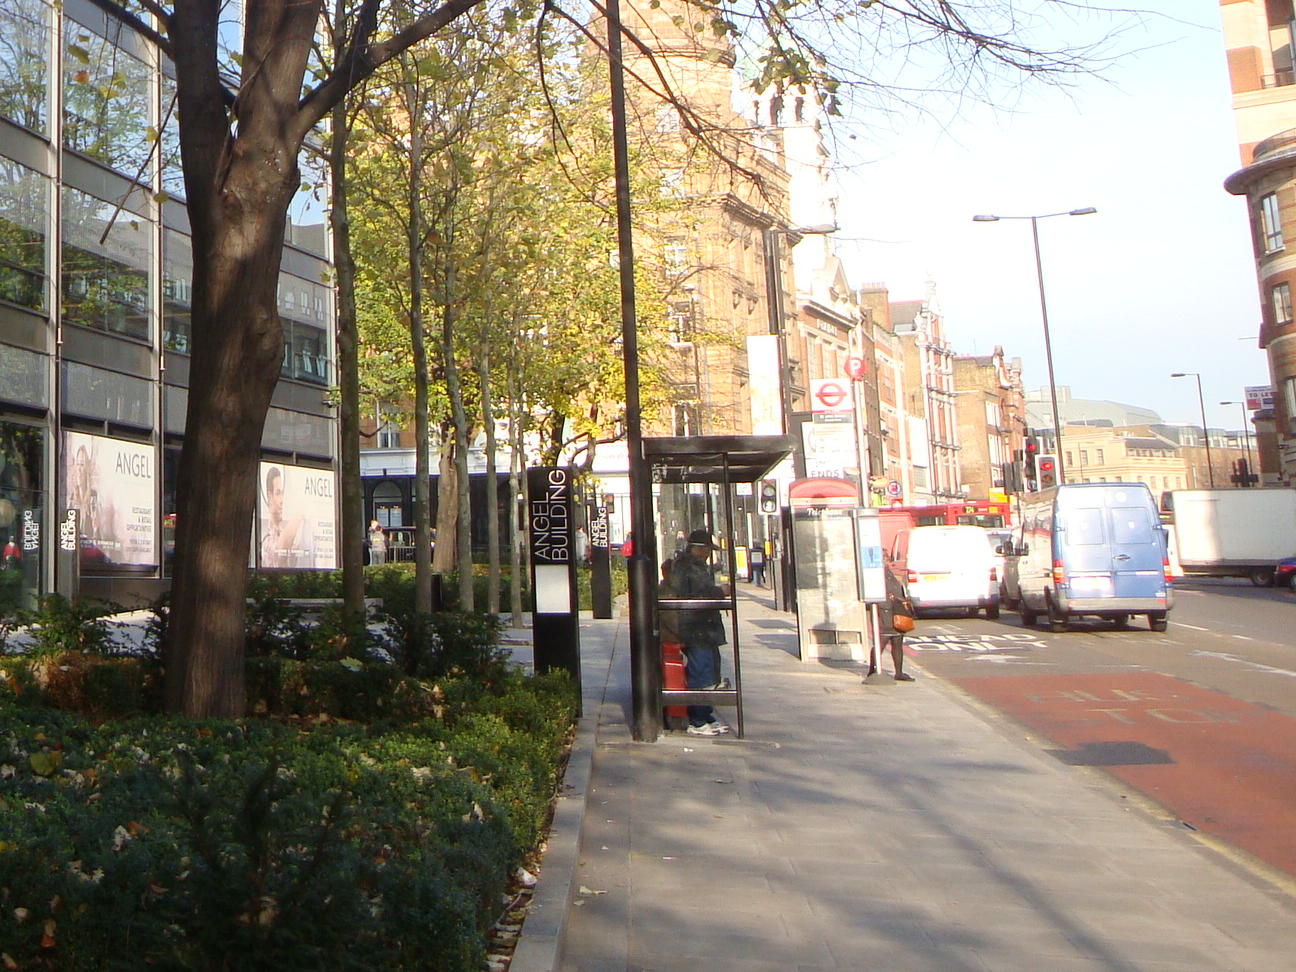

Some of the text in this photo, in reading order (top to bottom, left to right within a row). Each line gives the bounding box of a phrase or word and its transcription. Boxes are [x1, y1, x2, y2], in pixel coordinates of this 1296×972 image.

[849, 359, 861, 376] P
[115, 451, 152, 479] ANGEL
[304, 477, 333, 499] ANGEL
[67, 508, 76, 551] BUILDING
[532, 492, 551, 561] ANGEL
[548, 469, 569, 562] BUILDING
[597, 507, 608, 548] BUILDING
[60, 521, 69, 550] ANGEL
[591, 516, 600, 547] ANGEL
[902, 633, 1037, 643] AHEAD
[909, 640, 1048, 652] ONLY
